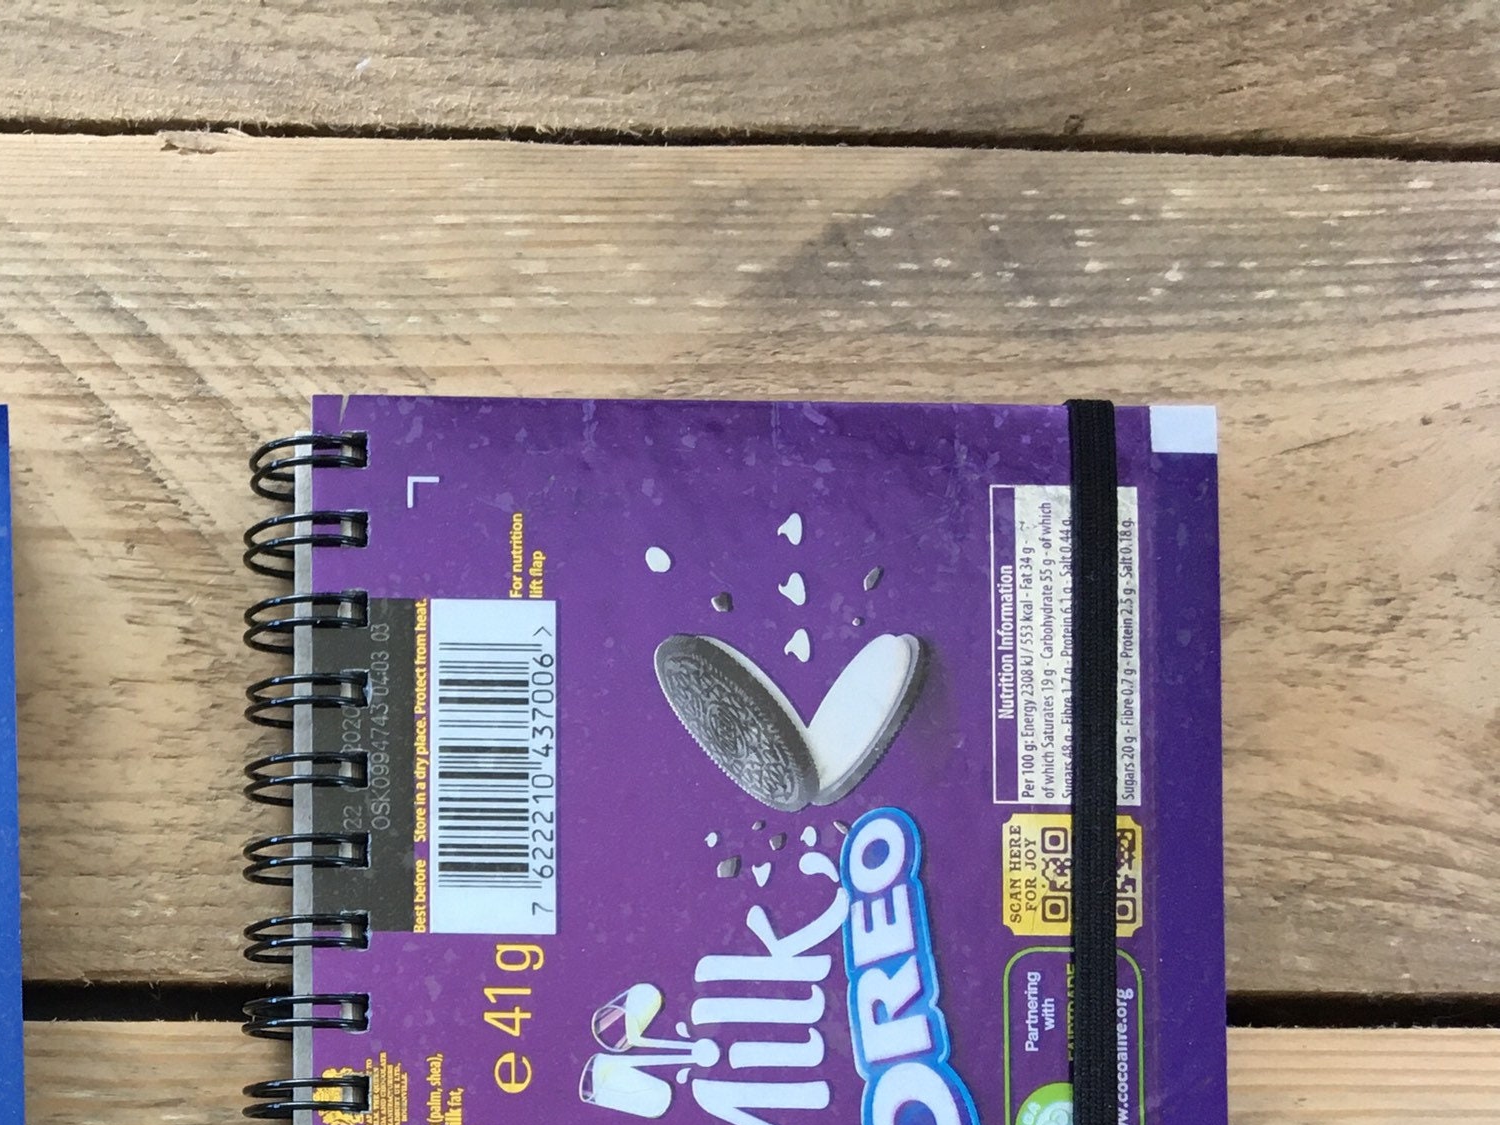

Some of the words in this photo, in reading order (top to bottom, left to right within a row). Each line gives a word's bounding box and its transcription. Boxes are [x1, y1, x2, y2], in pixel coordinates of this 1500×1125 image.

[509, 513, 523, 572] nutrition
[529, 551, 546, 577] flap
[509, 575, 523, 598] For
[529, 579, 543, 598] lift
[414, 598, 427, 631] heat.
[996, 565, 1014, 650] Information
[414, 634, 427, 665] from
[414, 667, 427, 714] Protect
[998, 654, 1014, 719] Nutrition
[414, 717, 429, 755] place.
[414, 757, 429, 780] dry
[414, 792, 426, 805] in
[416, 782, 426, 790] a
[413, 807, 427, 842] Store
[1009, 825, 1022, 872] HERE
[1024, 838, 1037, 870] JOY
[414, 859, 426, 902] before
[1025, 877, 1041, 913] FOR
[1009, 878, 1022, 923] SCAN
[413, 905, 426, 933] Best
[1024, 972, 1043, 1051] Partnering
[1041, 998, 1055, 1031] with
